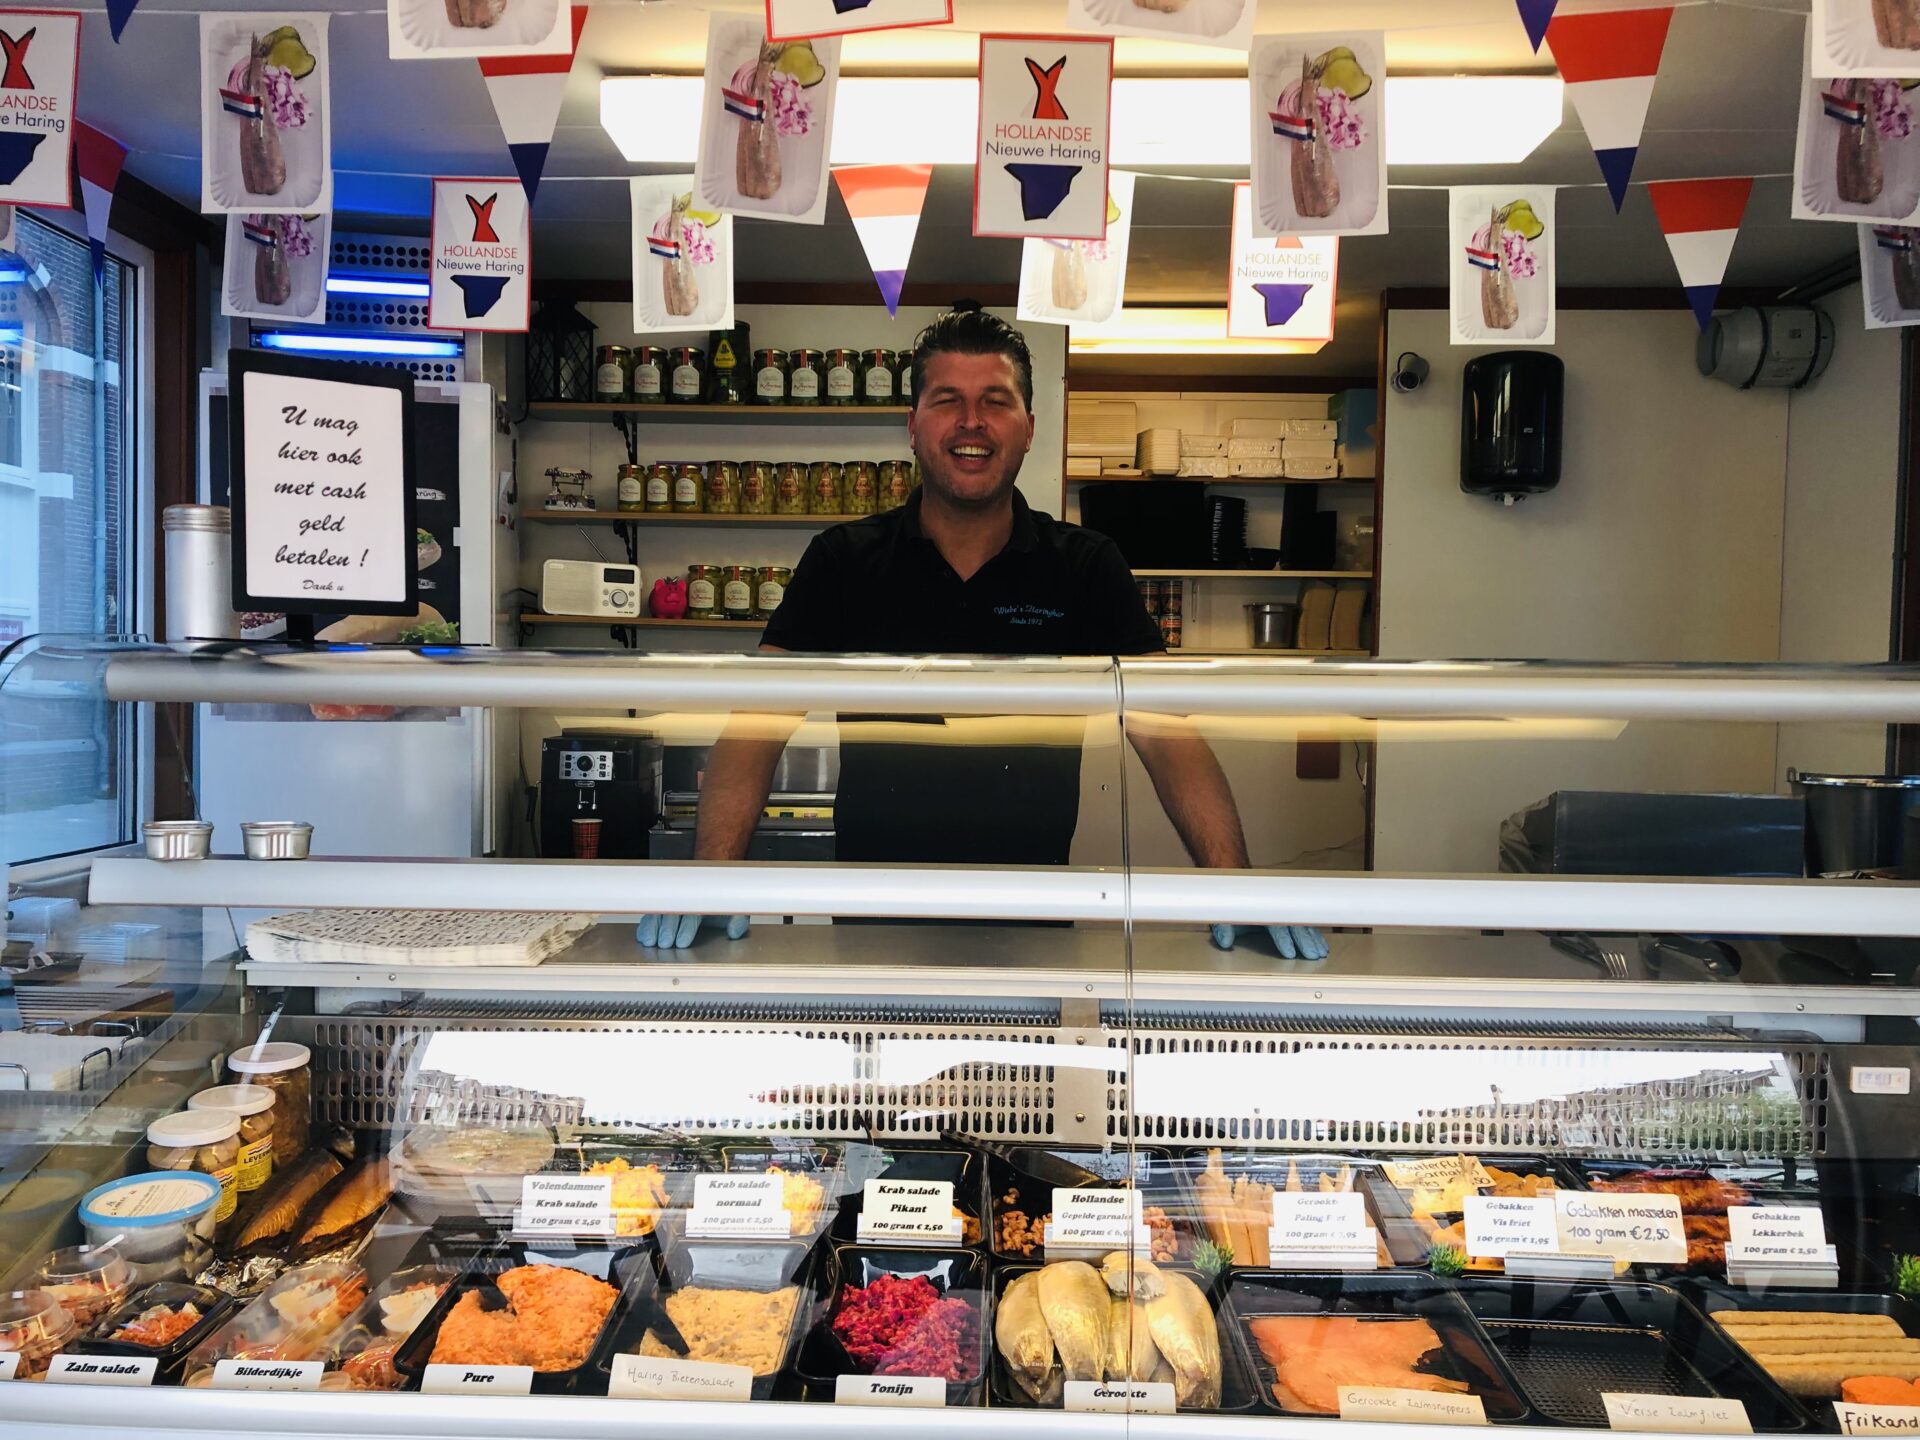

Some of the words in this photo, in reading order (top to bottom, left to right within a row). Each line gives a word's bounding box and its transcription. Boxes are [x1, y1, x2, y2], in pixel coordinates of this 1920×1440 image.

[16, 112, 65, 133] Haring
[994, 123, 1092, 142] HOLLANDSE
[986, 141, 1044, 157] Nieuwe
[1050, 143, 1101, 164] Haring
[443, 244, 518, 259] HOLLANDSE
[1244, 253, 1323, 266] HOLLANDSE
[436, 259, 481, 271] Nieuwe
[485, 260, 524, 275] Haring
[1237, 266, 1284, 278] Nieuwe
[1287, 267, 1329, 281] Haring
[281, 405, 307, 426] U
[313, 417, 359, 437] mag
[278, 441, 319, 461] hier
[326, 447, 363, 465] ook
[274, 481, 315, 496] met
[321, 482, 367, 499] cash
[299, 514, 346, 536] geld
[275, 544, 350, 566] betalen
[359, 548, 369, 567] !
[302, 579, 334, 591] Dank
[531, 1181, 606, 1191] Volendammer
[708, 1180, 736, 1189] Krab
[737, 1180, 771, 1189] salade
[878, 1185, 906, 1194] Krab
[906, 1187, 941, 1196] salade
[536, 1199, 563, 1208] Krab
[564, 1200, 598, 1209] salade
[715, 1198, 763, 1207] normaal
[1071, 1194, 1125, 1204] Hollandse
[889, 1203, 928, 1214] Pikant
[1486, 1202, 1534, 1211] Gebakken
[530, 1217, 547, 1225] 100
[547, 1218, 573, 1226] gram
[703, 1216, 720, 1224] 100
[720, 1216, 746, 1225] gram
[1062, 1212, 1096, 1221] Gepelde
[1294, 1213, 1324, 1223] Paling
[1752, 1212, 1801, 1221] Gebakken
[889, 1223, 915, 1231] gram
[1492, 1218, 1508, 1227] Vis
[1062, 1228, 1080, 1236] 100
[1080, 1228, 1105, 1237] gram
[1303, 1231, 1328, 1239] gram
[1566, 1226, 1591, 1238] 100
[1595, 1227, 1627, 1244] gram
[1752, 1229, 1805, 1238] Lekkerbek
[1476, 1235, 1493, 1243] 100
[1494, 1236, 1520, 1244] gram
[1761, 1247, 1788, 1255] gram
[64, 1362, 98, 1373] Zalm
[99, 1363, 140, 1374] salade
[234, 1367, 303, 1379] Bilderdijkje
[462, 1372, 495, 1383] Pure
[627, 1367, 664, 1386] Haring
[870, 1383, 914, 1396] Tonijn
